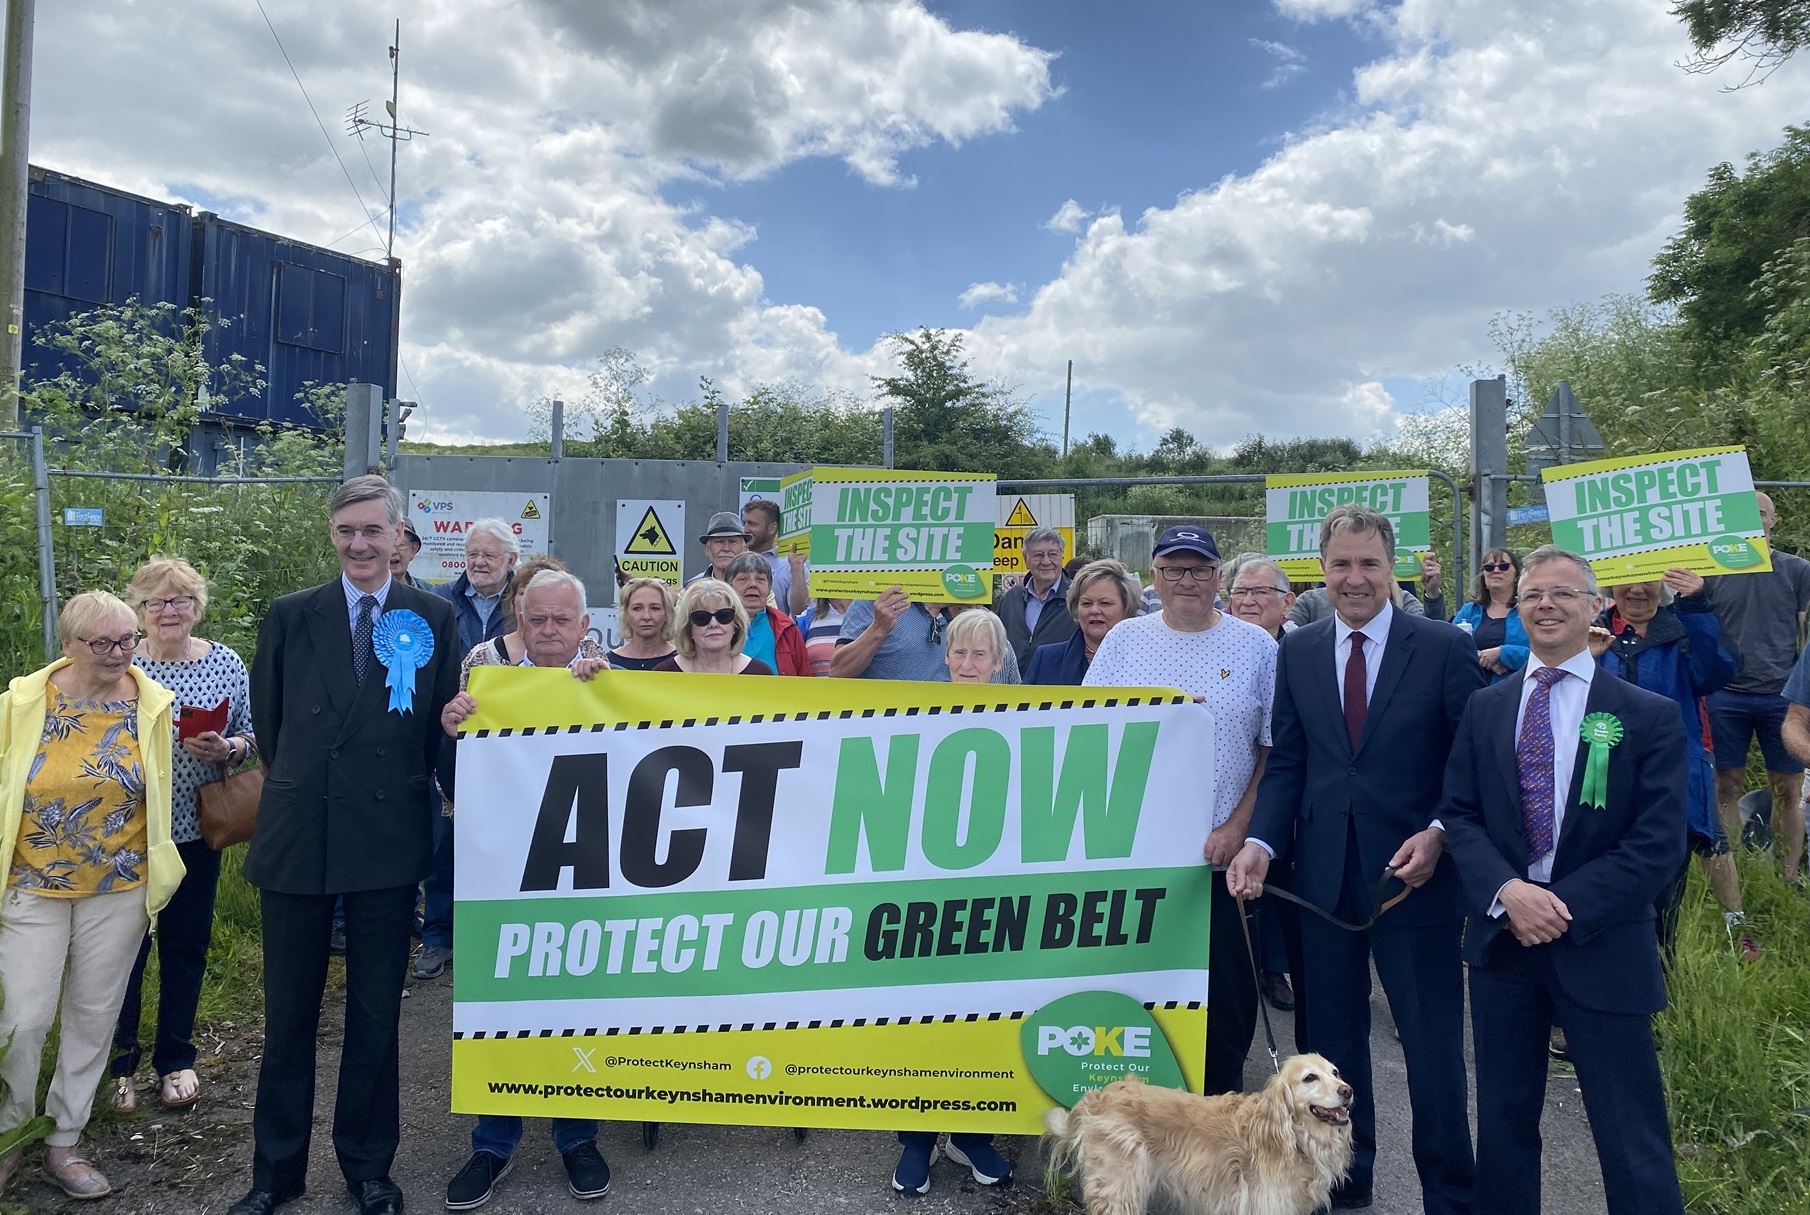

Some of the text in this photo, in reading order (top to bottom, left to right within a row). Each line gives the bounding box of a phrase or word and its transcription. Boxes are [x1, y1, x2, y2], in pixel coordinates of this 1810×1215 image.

[784, 478, 813, 510] INSPEC
[1574, 460, 1722, 515] INSPECT
[433, 502, 454, 511] VPS
[836, 485, 974, 523] INSPECT
[1287, 522, 1321, 552] TH
[1577, 499, 1726, 552] THE SITE
[834, 527, 965, 562] THE SITE
[1712, 543, 1748, 554] POKE
[621, 560, 679, 572] CAUTION
[945, 573, 976, 583] POKE
[993, 556, 1019, 569] eep
[519, 720, 1161, 892] ACT NOW
[493, 887, 1167, 980] PROTECT OUR GREEN BELT
[1037, 1025, 1152, 1058] POKE
[605, 1055, 732, 1072] @ProtectKeynsham
[784, 1063, 1015, 1079] @protectourkeynshamenvironment
[1081, 1061, 1150, 1072] Protect Our
[487, 1081, 1017, 1113] www.protectourkeynshamenvironment.wordpress.com
